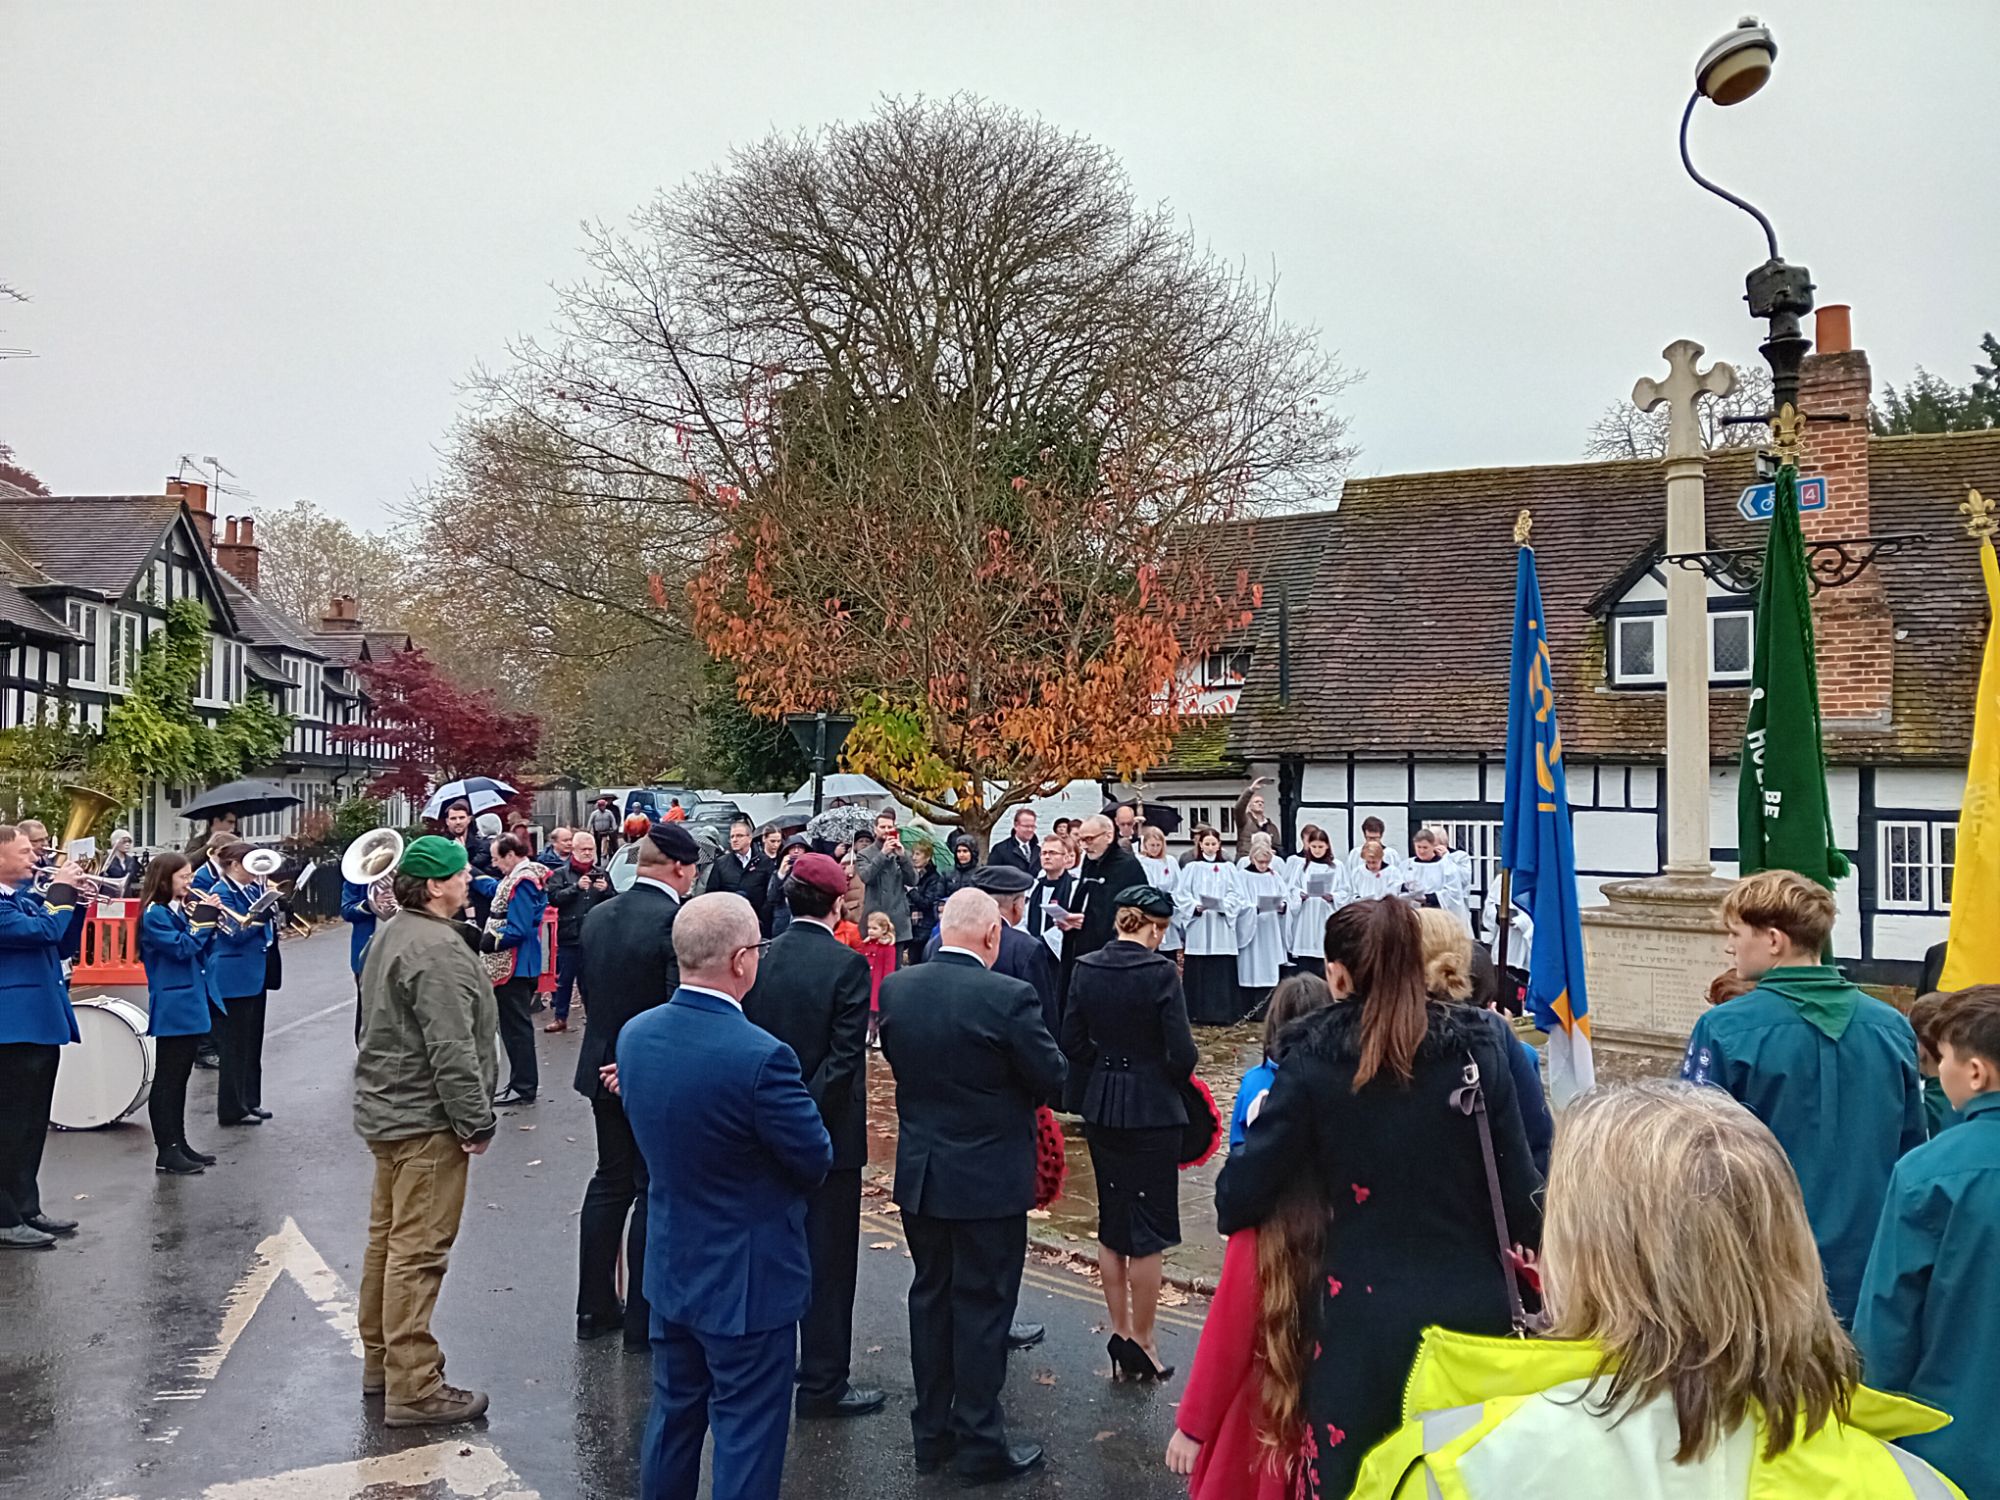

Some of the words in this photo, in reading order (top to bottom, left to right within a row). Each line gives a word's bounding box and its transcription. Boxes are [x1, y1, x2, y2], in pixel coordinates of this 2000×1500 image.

[1805, 488, 1817, 500] 4
[1604, 930, 1630, 939] LEST
[1636, 932, 1651, 941] WE
[1657, 934, 1699, 944] FORGET
